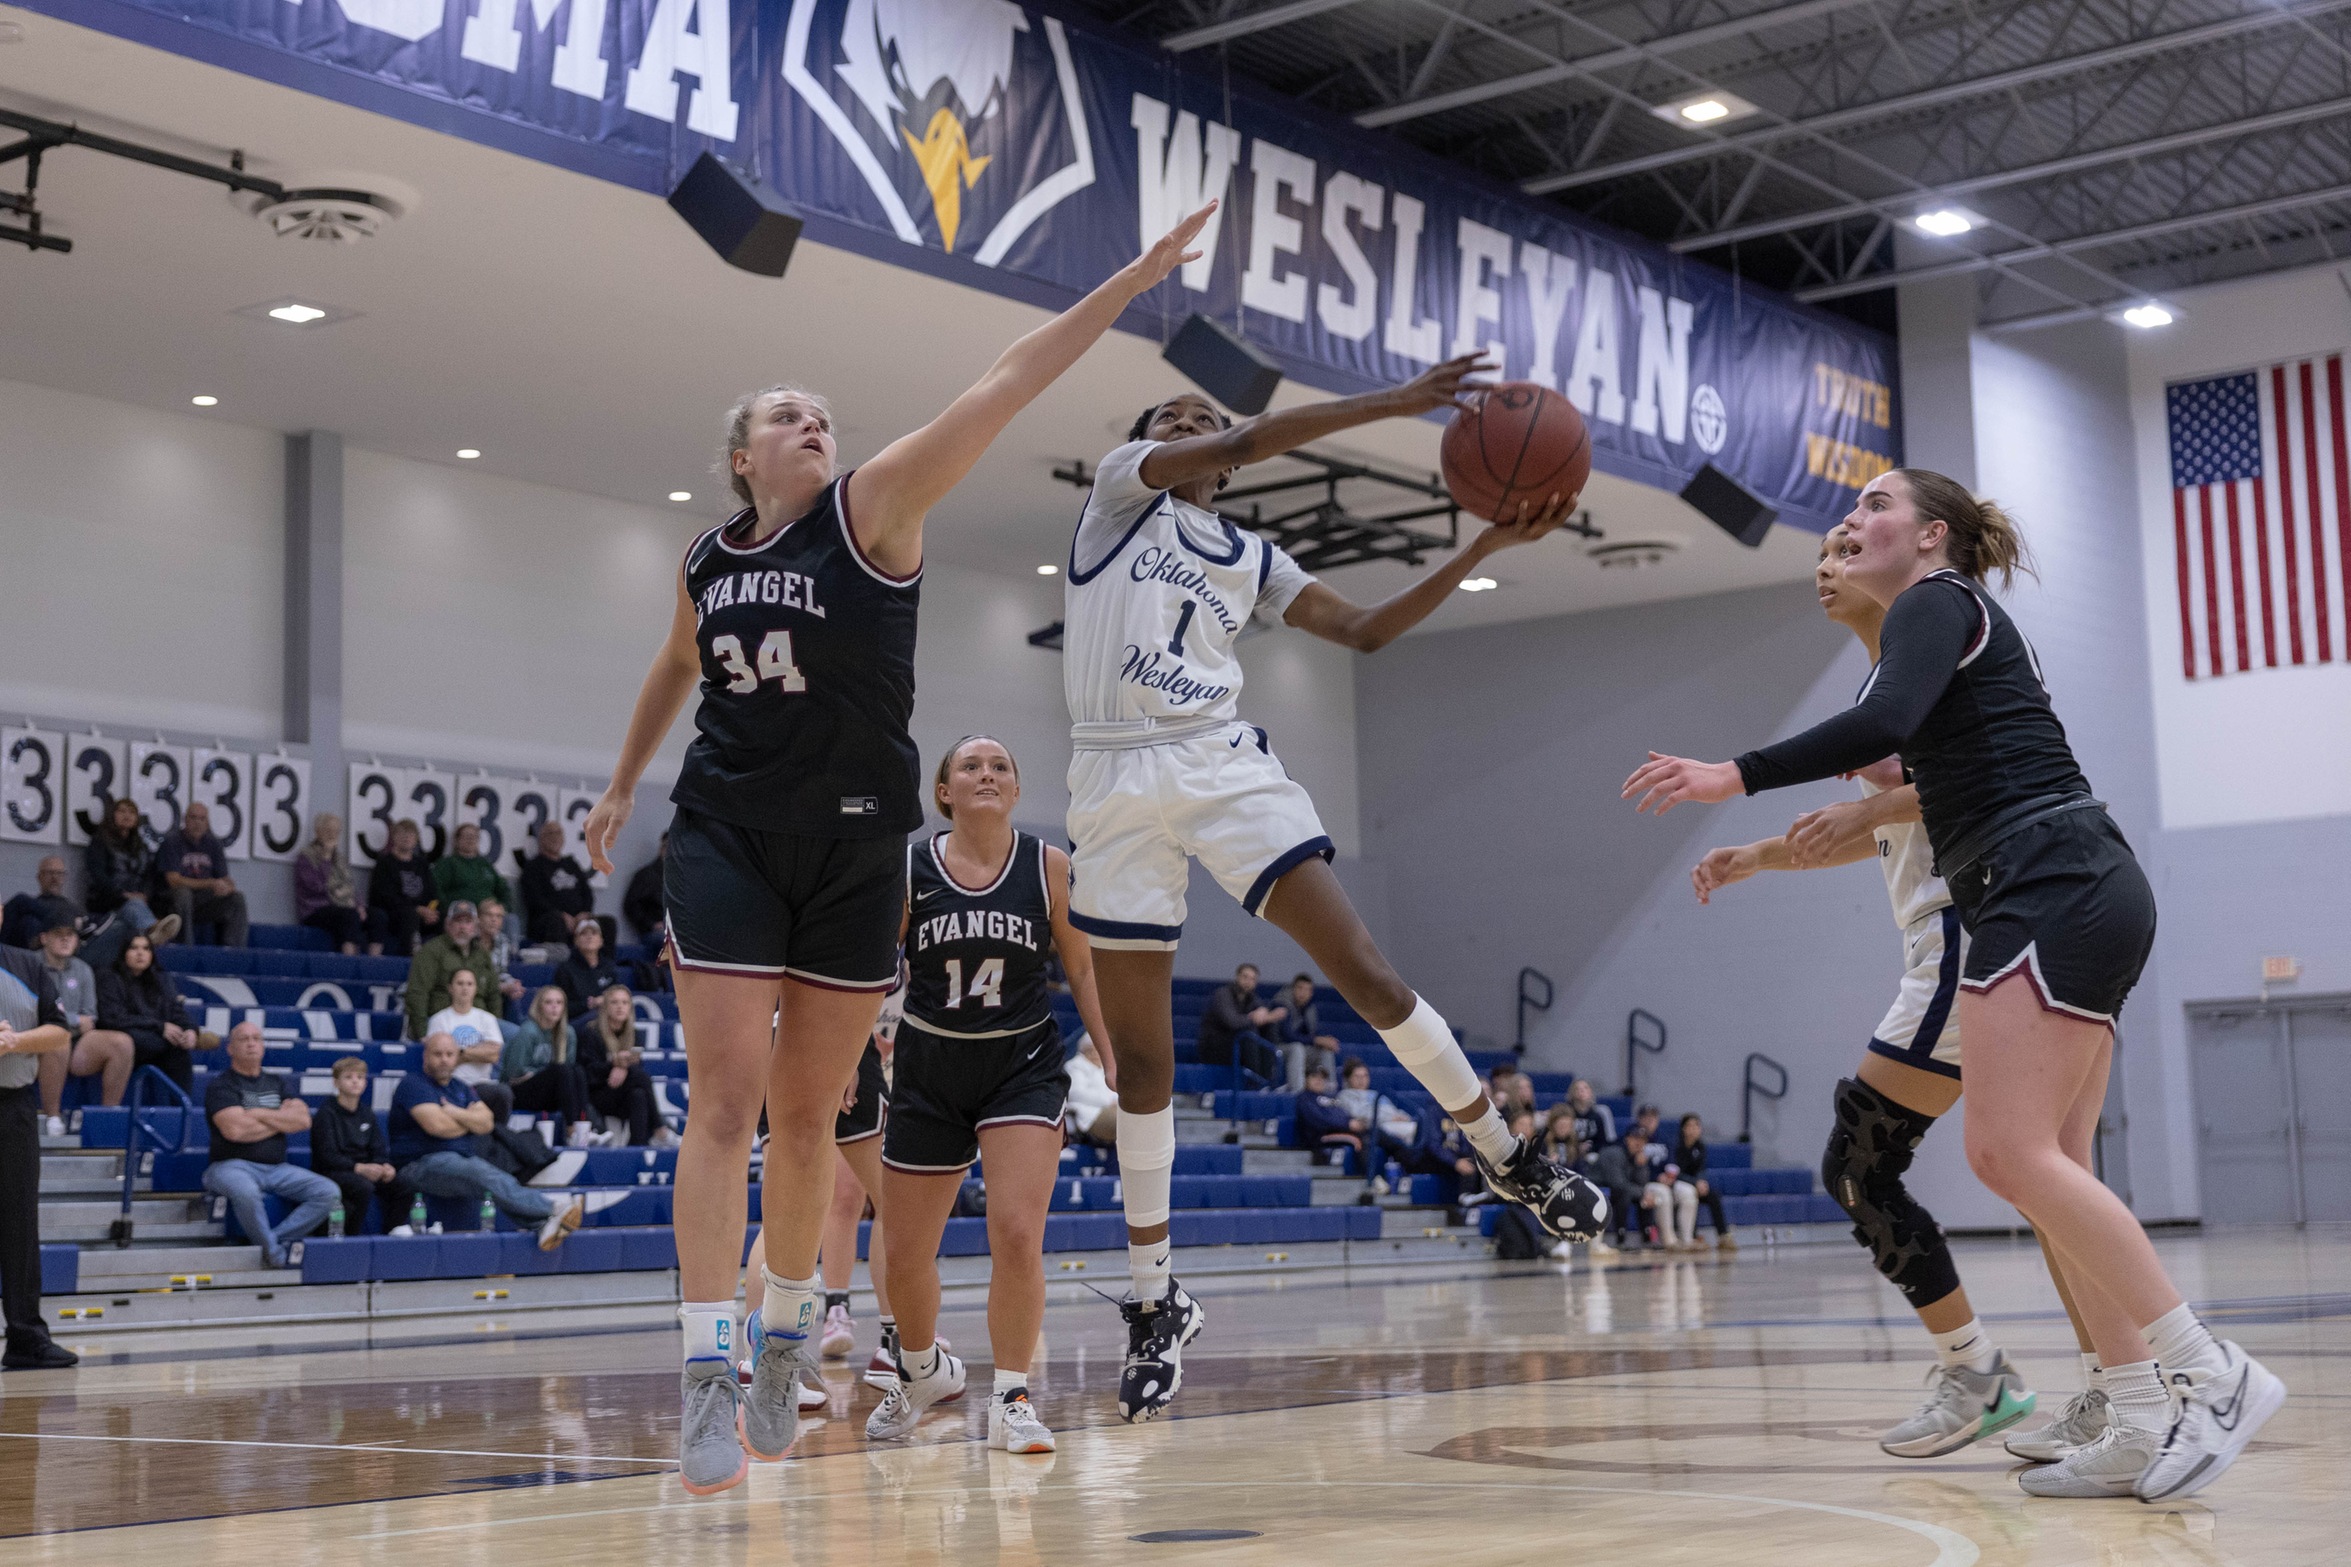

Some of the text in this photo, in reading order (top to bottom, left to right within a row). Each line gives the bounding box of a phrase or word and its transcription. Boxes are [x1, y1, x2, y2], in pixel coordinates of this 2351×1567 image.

[1132, 93, 1694, 446] WESLEYAN
[1130, 546, 1239, 636] Oklahoma
[1167, 599, 1198, 658] 1
[712, 630, 806, 694] 34
[1120, 644, 1229, 705] Wesleyan
[8, 737, 300, 853] 3 3 3 3 3
[357, 773, 394, 860] 3
[411, 781, 446, 862] 3
[865, 801, 876, 810] XL
[918, 910, 1038, 952] EVANGEL
[945, 958, 1005, 1009] 14
